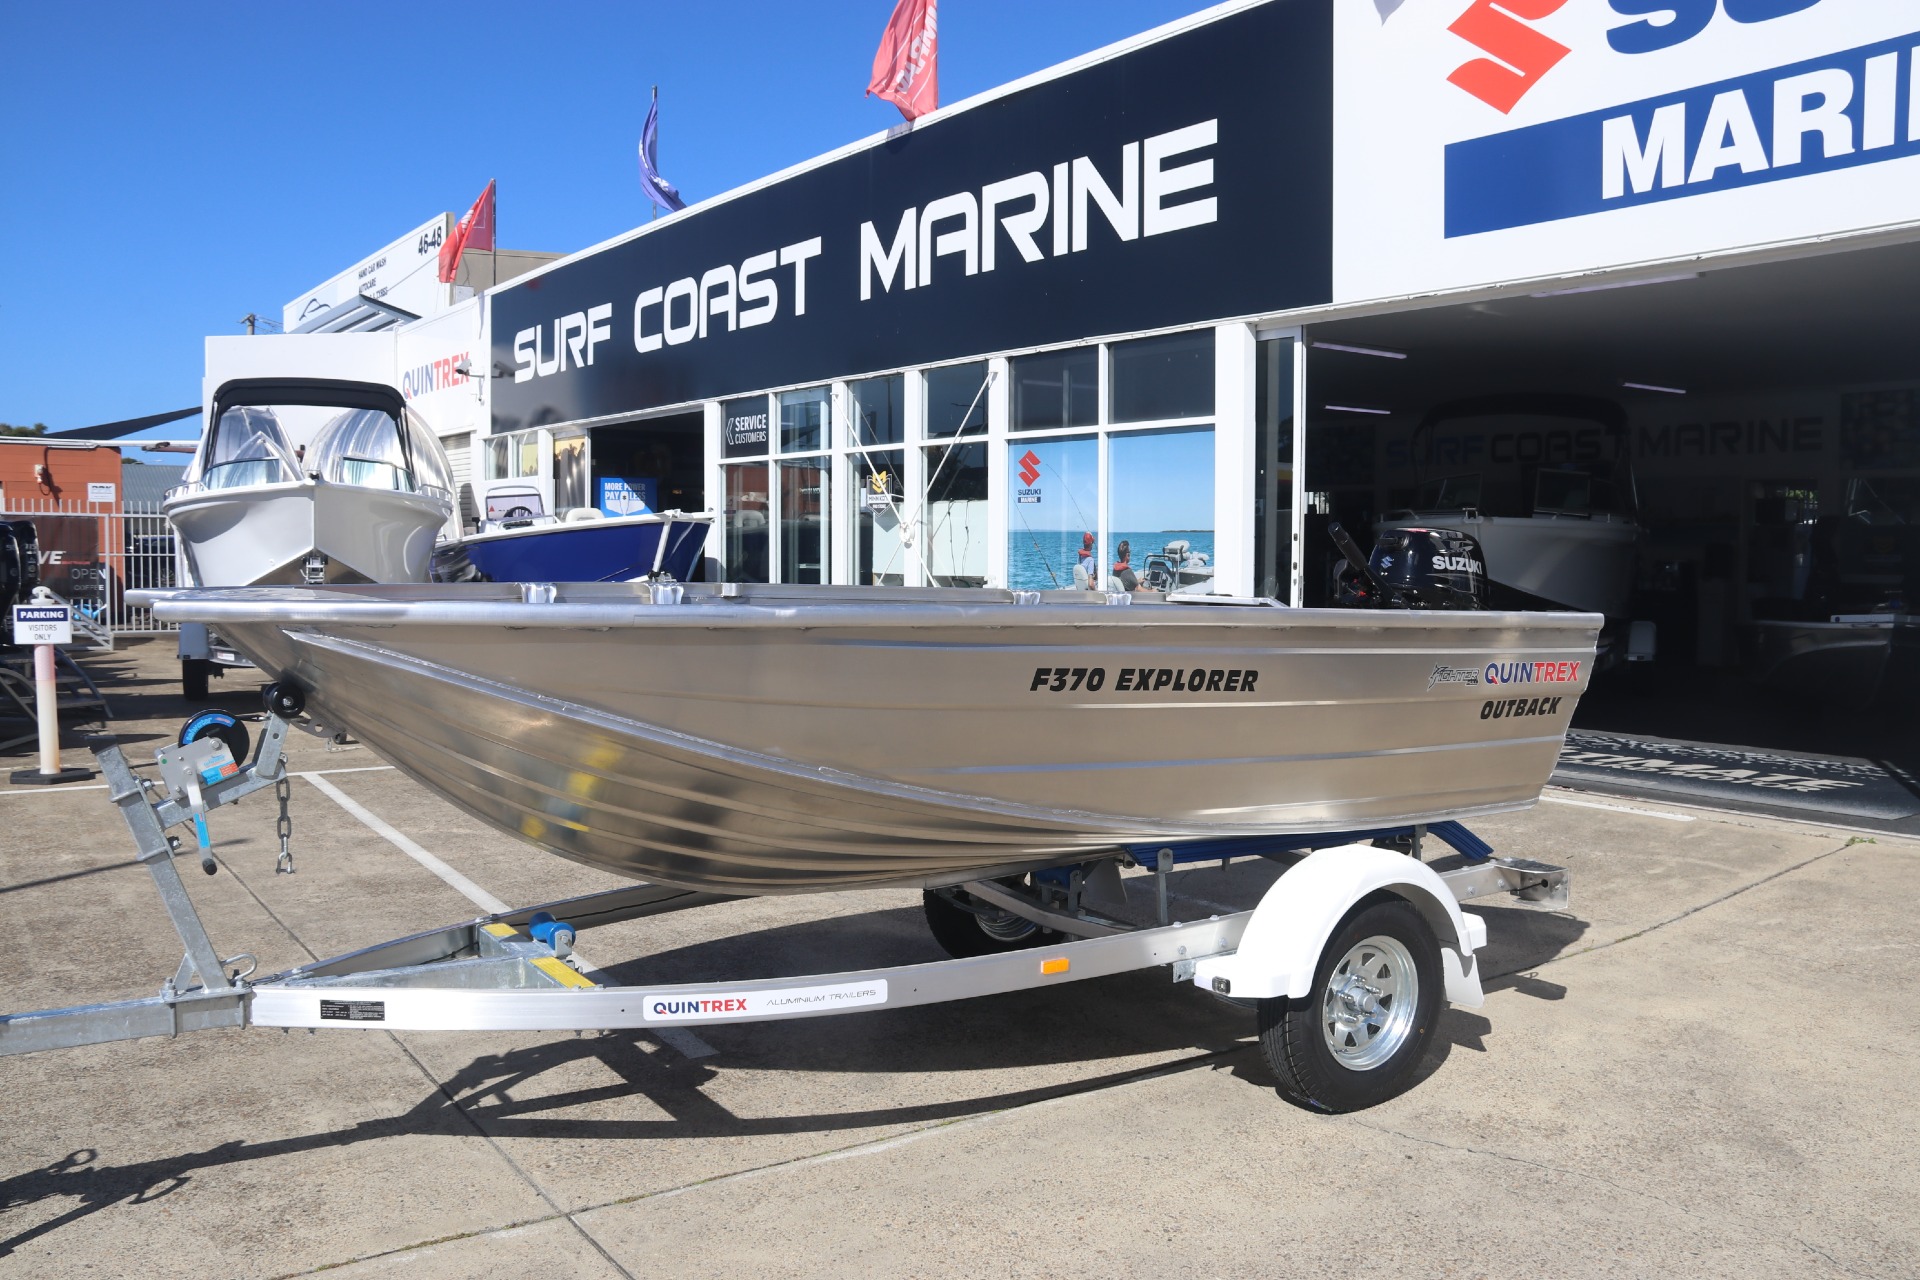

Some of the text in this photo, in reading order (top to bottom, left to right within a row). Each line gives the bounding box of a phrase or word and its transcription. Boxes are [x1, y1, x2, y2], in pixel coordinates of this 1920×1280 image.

[896, 0, 938, 94] GARMI
[1603, 45, 1920, 200] MARI
[418, 226, 442, 255] 46-48
[514, 118, 1218, 384] SURF COAST MARINE
[368, 262, 376, 274] CAR
[376, 256, 387, 270] WASH
[735, 413, 767, 432] SERVICE
[734, 430, 767, 445] CUSTOMERS
[1639, 417, 1824, 458] MARINE
[604, 482, 646, 491] MORE POWER
[604, 490, 646, 501] PAY LESS
[1017, 488, 1042, 496] SUZUKI
[37, 550, 62, 565] VE
[1432, 555, 1483, 574] SUZUKI
[71, 568, 107, 580] OPEN
[20, 611, 64, 619] PARKING
[28, 624, 58, 632] VISITORS
[34, 633, 52, 641] ONLY
[1029, 667, 1259, 692] F370 EXPLORER
[1484, 661, 1581, 686] QUINTREX
[1480, 696, 1563, 720] OUTBACK
[653, 989, 877, 1015] QUINTREX ALUMINIUM TRAILERS
